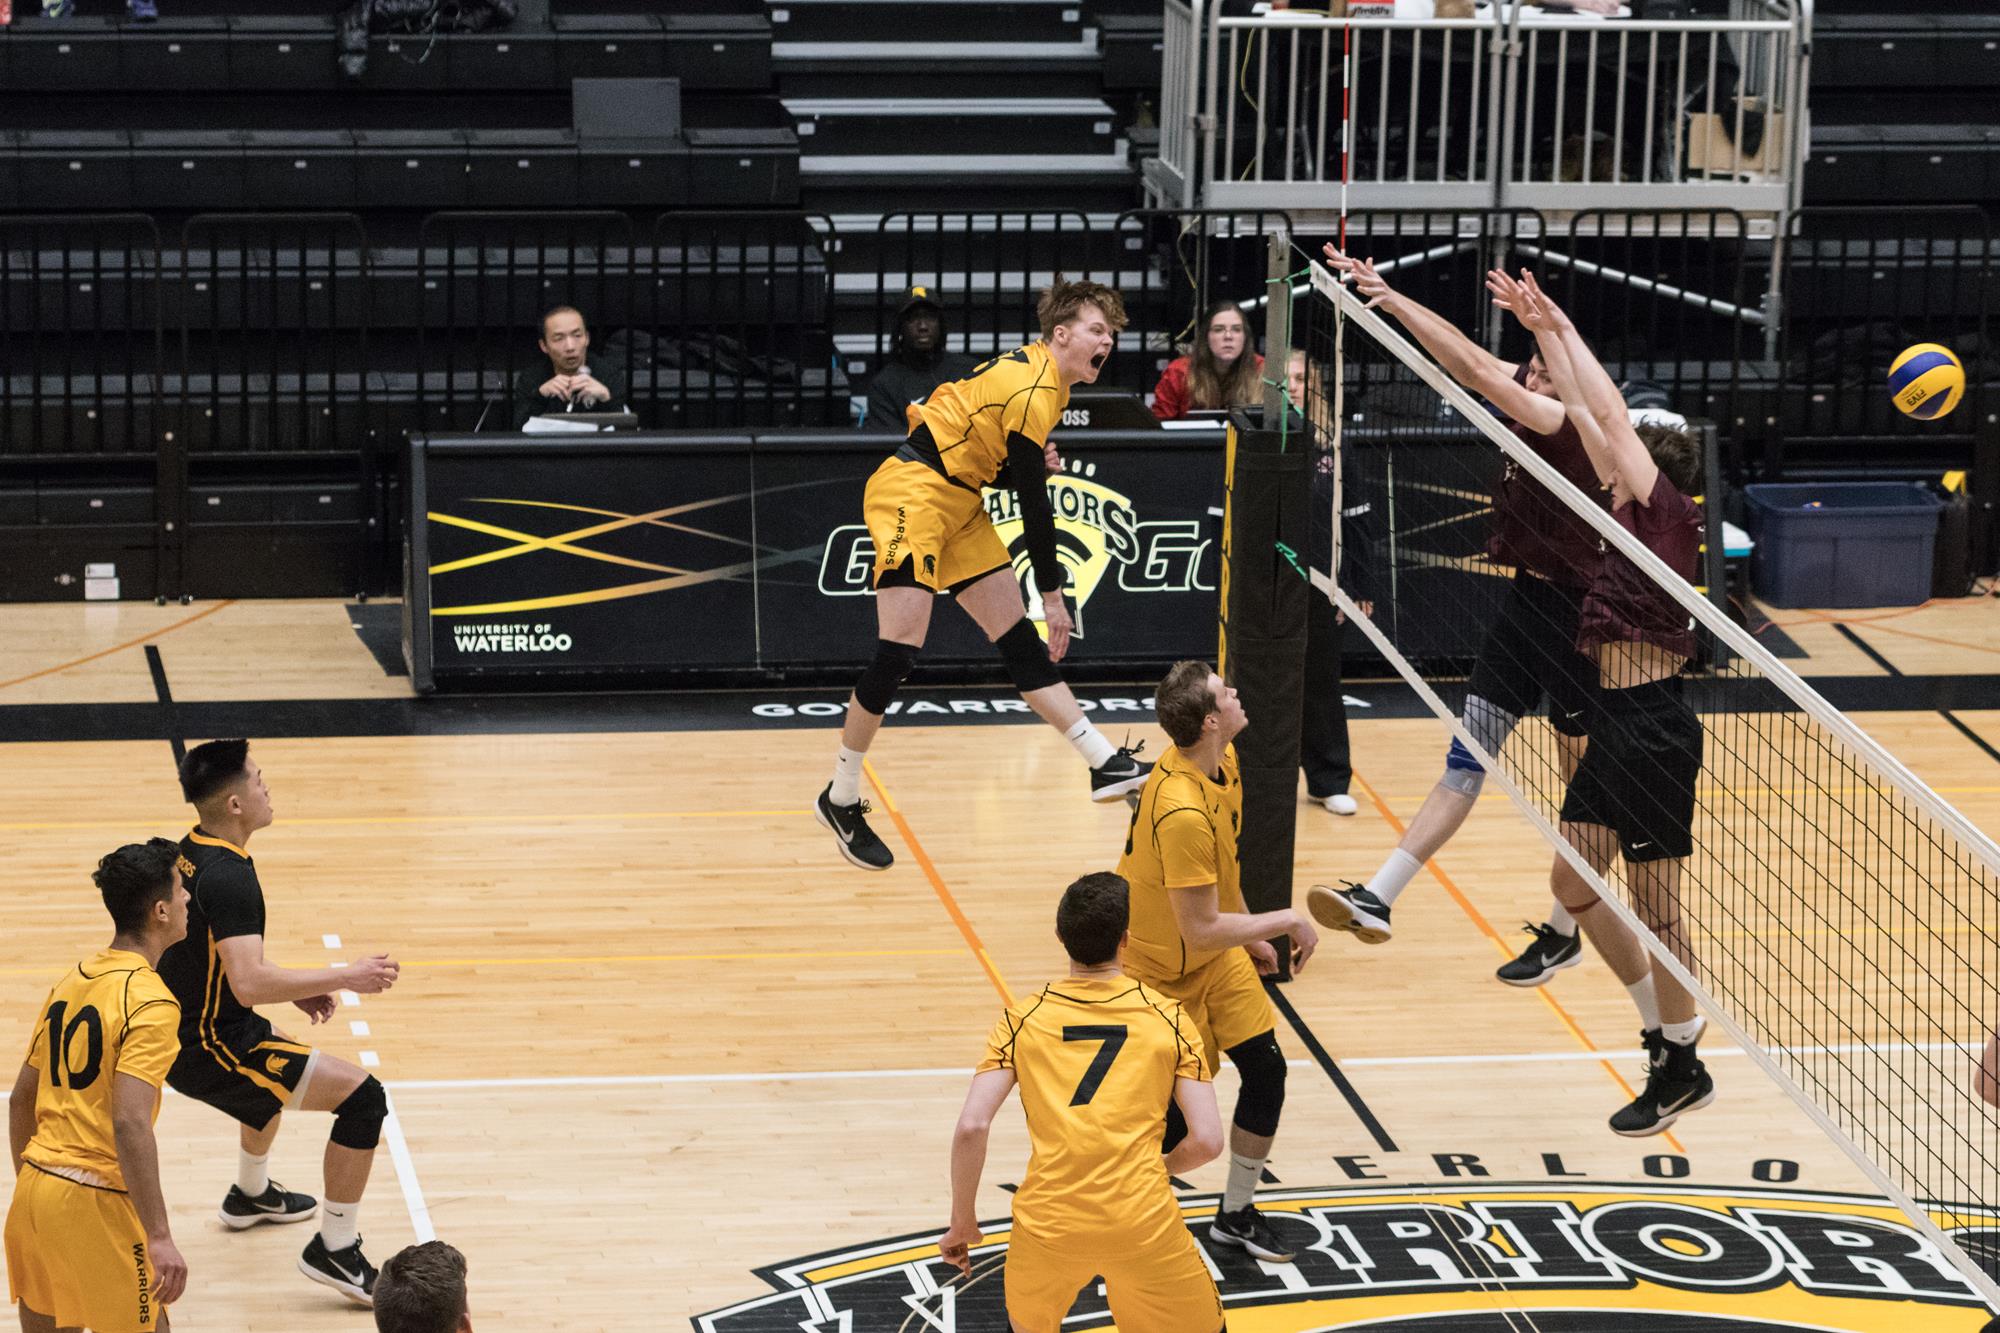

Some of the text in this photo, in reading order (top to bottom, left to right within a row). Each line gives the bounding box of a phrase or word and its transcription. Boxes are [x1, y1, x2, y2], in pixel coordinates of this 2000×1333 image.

[1062, 409, 1090, 426] OSS
[453, 623, 551, 634] UNIVERSITY OF
[454, 634, 573, 652] WATERLOO
[44, 1000, 103, 1090] 10
[1062, 1024, 1128, 1107] 7
[133, 1243, 150, 1324] WARRIORS
